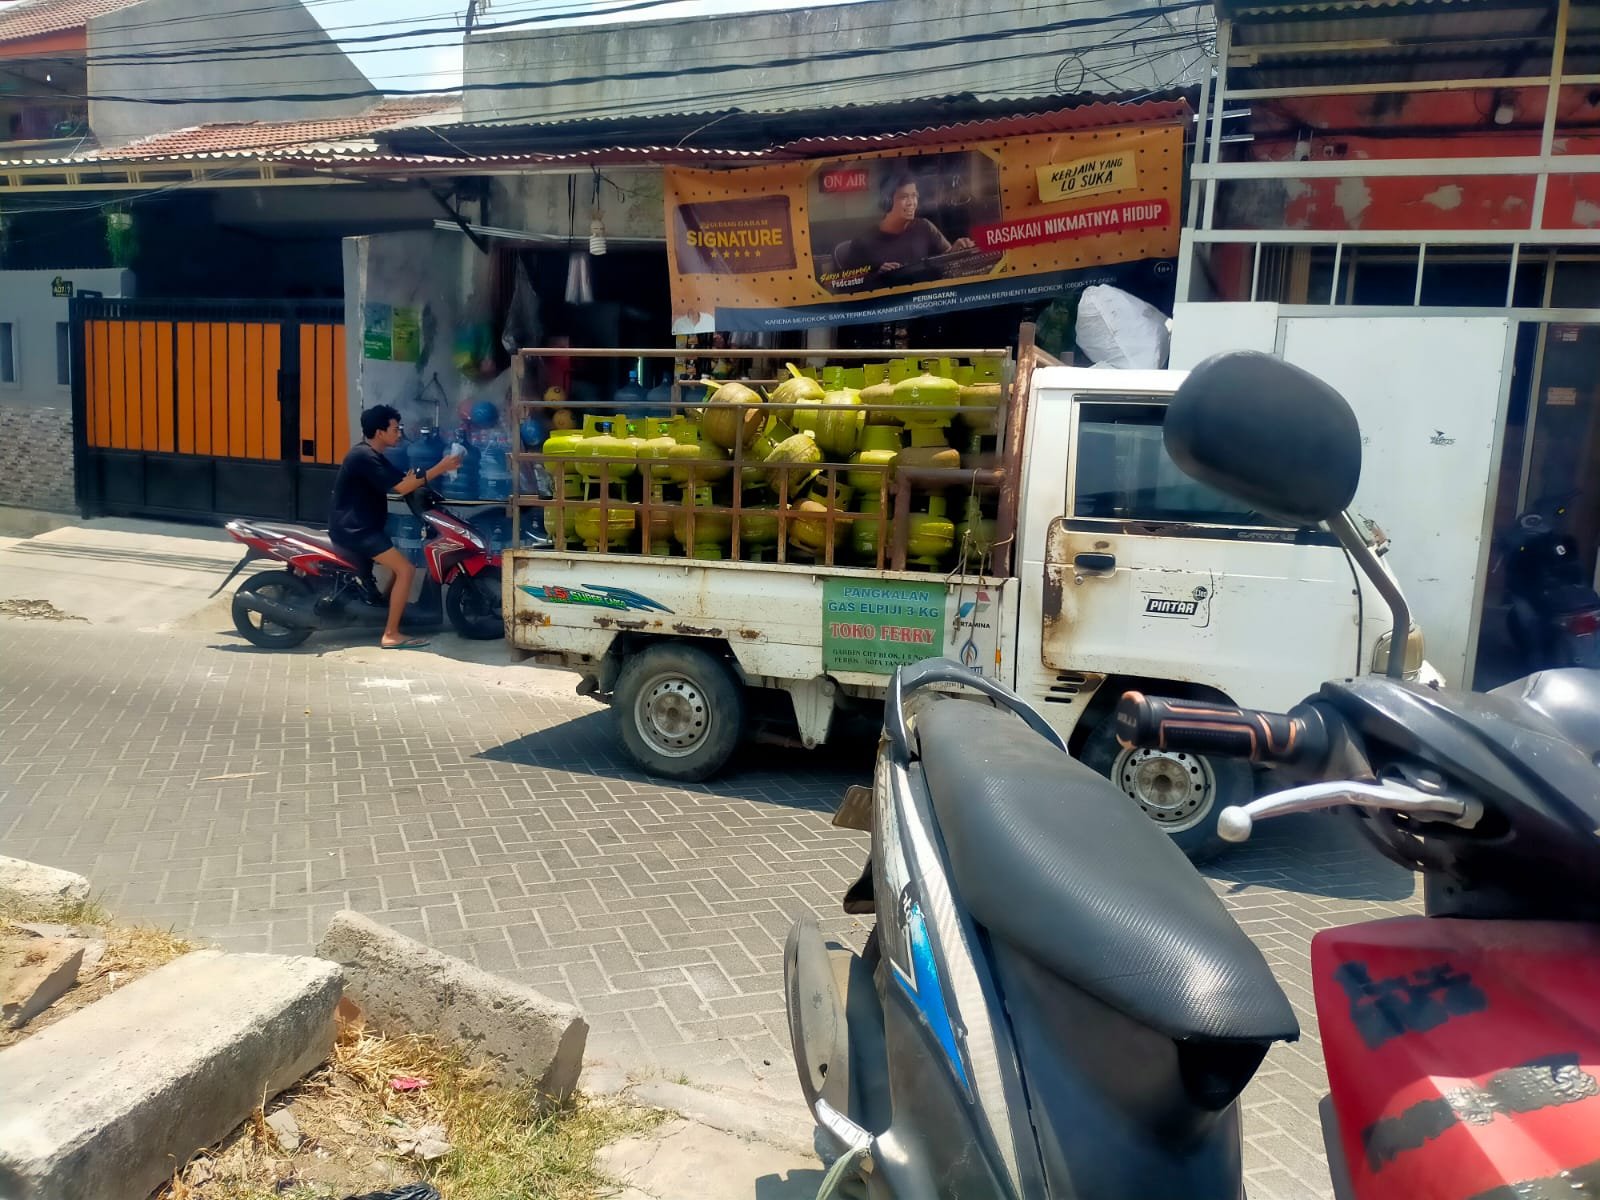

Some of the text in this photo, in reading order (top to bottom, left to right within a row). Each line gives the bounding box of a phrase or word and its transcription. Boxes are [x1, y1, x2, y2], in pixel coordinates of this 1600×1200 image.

[1051, 158, 1123, 182] KERJAIN YANG
[823, 173, 866, 188] ON AIR
[1061, 170, 1113, 192] LO SUKA
[987, 204, 1162, 245] RASAKAN NIKMATNYA HIDUP
[686, 228, 783, 247] SIGNATURE
[831, 277, 864, 288] Podcaster
[765, 318, 792, 326] KARENA
[877, 304, 904, 315] KANKER
[991, 289, 1027, 300] BERHENTI
[843, 587, 929, 602] PANGKALAN
[828, 602, 939, 617] GAS ELPIJI 3 KG
[1150, 601, 1195, 613] PINTAR
[829, 623, 936, 644] TOKO FERRY
